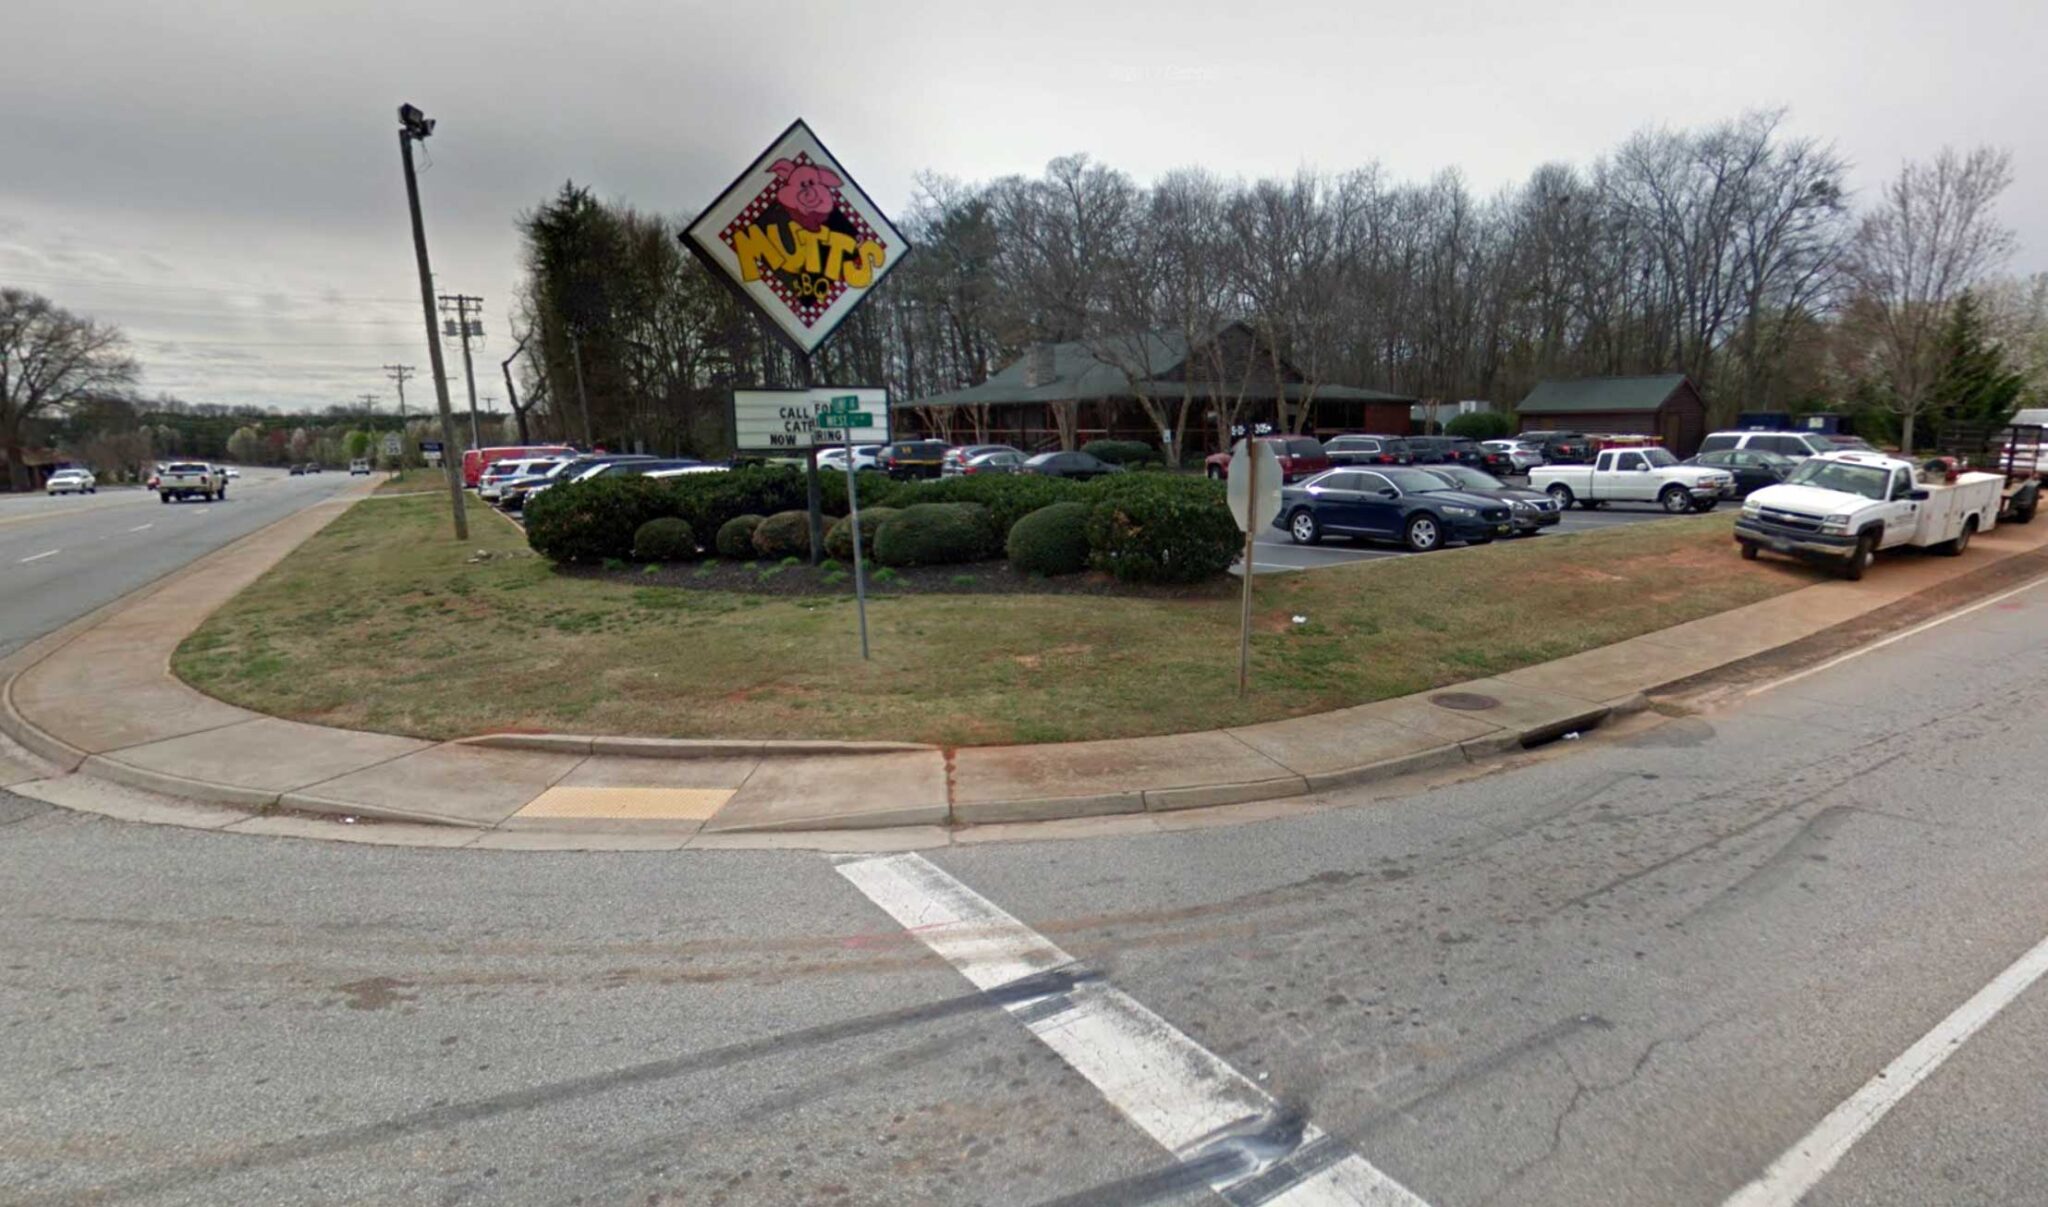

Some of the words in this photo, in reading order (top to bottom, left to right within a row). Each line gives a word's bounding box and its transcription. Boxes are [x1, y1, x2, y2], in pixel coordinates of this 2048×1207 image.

[734, 221, 886, 288] MUTTS
[779, 407, 809, 419] CALL
[814, 403, 834, 415] FO
[769, 434, 797, 446] NOW
